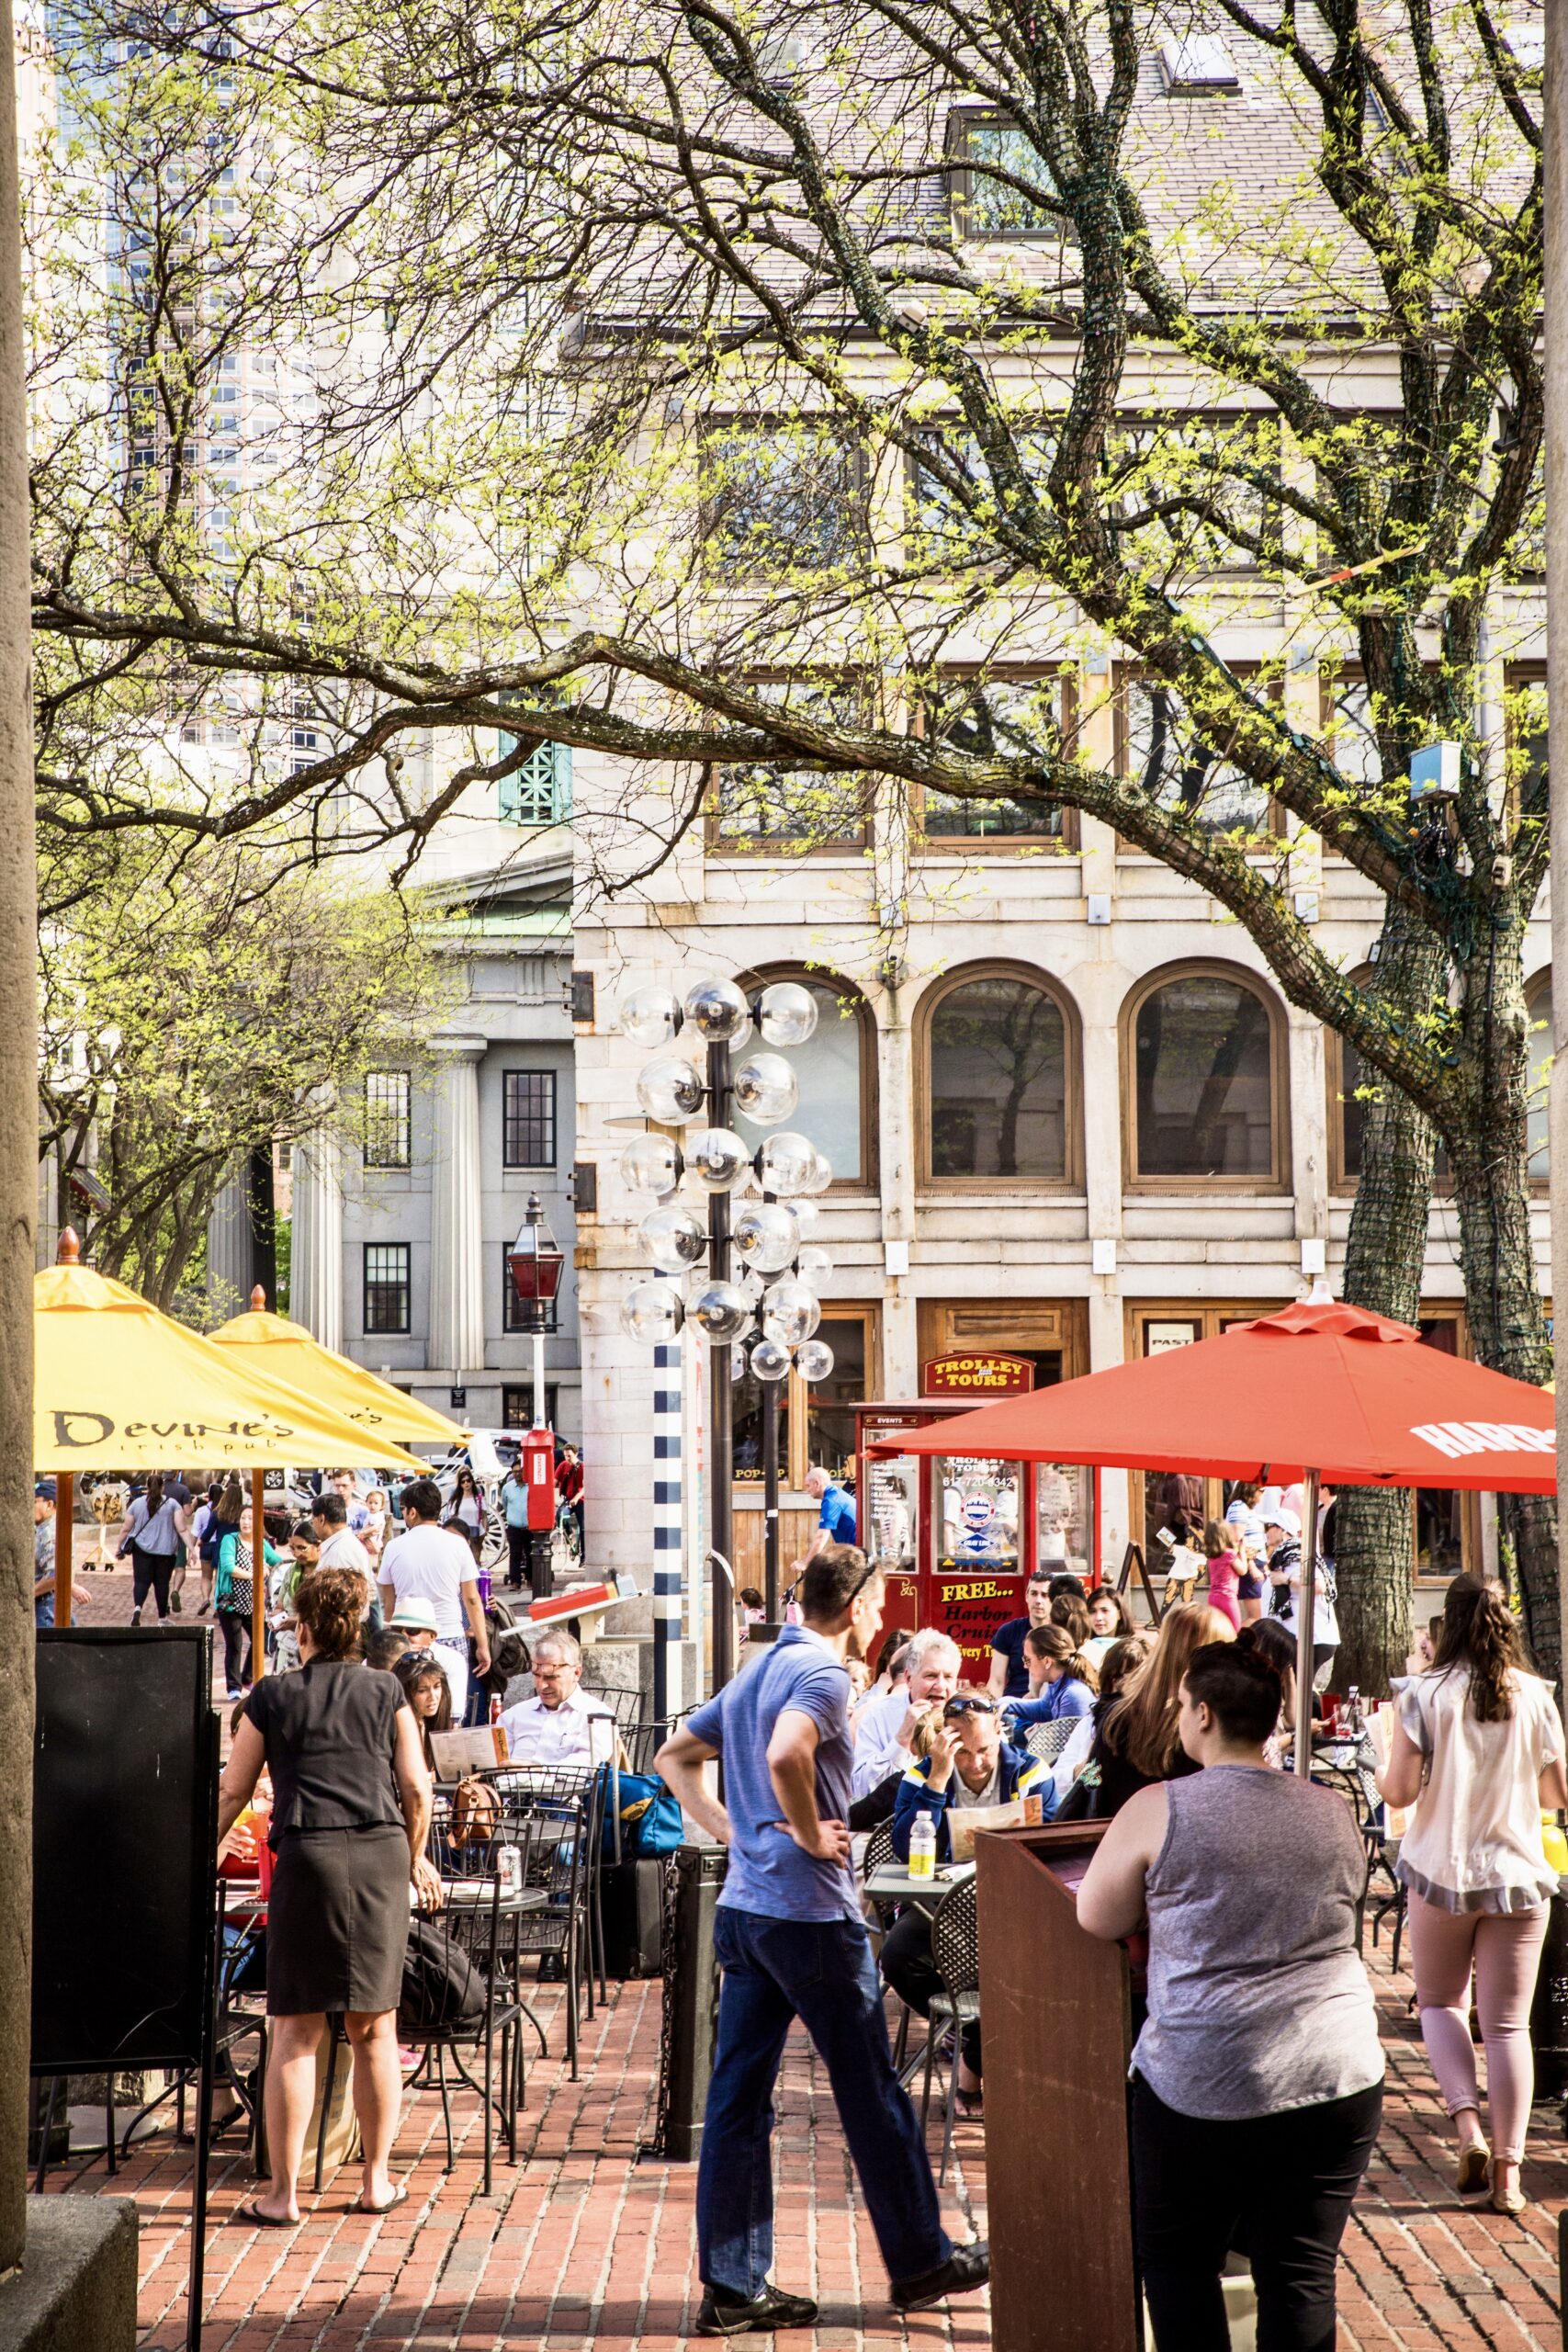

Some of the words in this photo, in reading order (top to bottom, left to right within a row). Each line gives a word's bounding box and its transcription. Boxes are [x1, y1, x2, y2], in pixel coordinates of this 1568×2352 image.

[934, 1359, 1022, 1375] TROLLEY
[946, 1374, 1009, 1386] TOURS
[120, 1440, 205, 1451] irish
[223, 1440, 277, 1454] pub
[735, 1469, 785, 1478] POP-P
[941, 1580, 1014, 1602] FREE...
[943, 1606, 1013, 1622] Harbor
